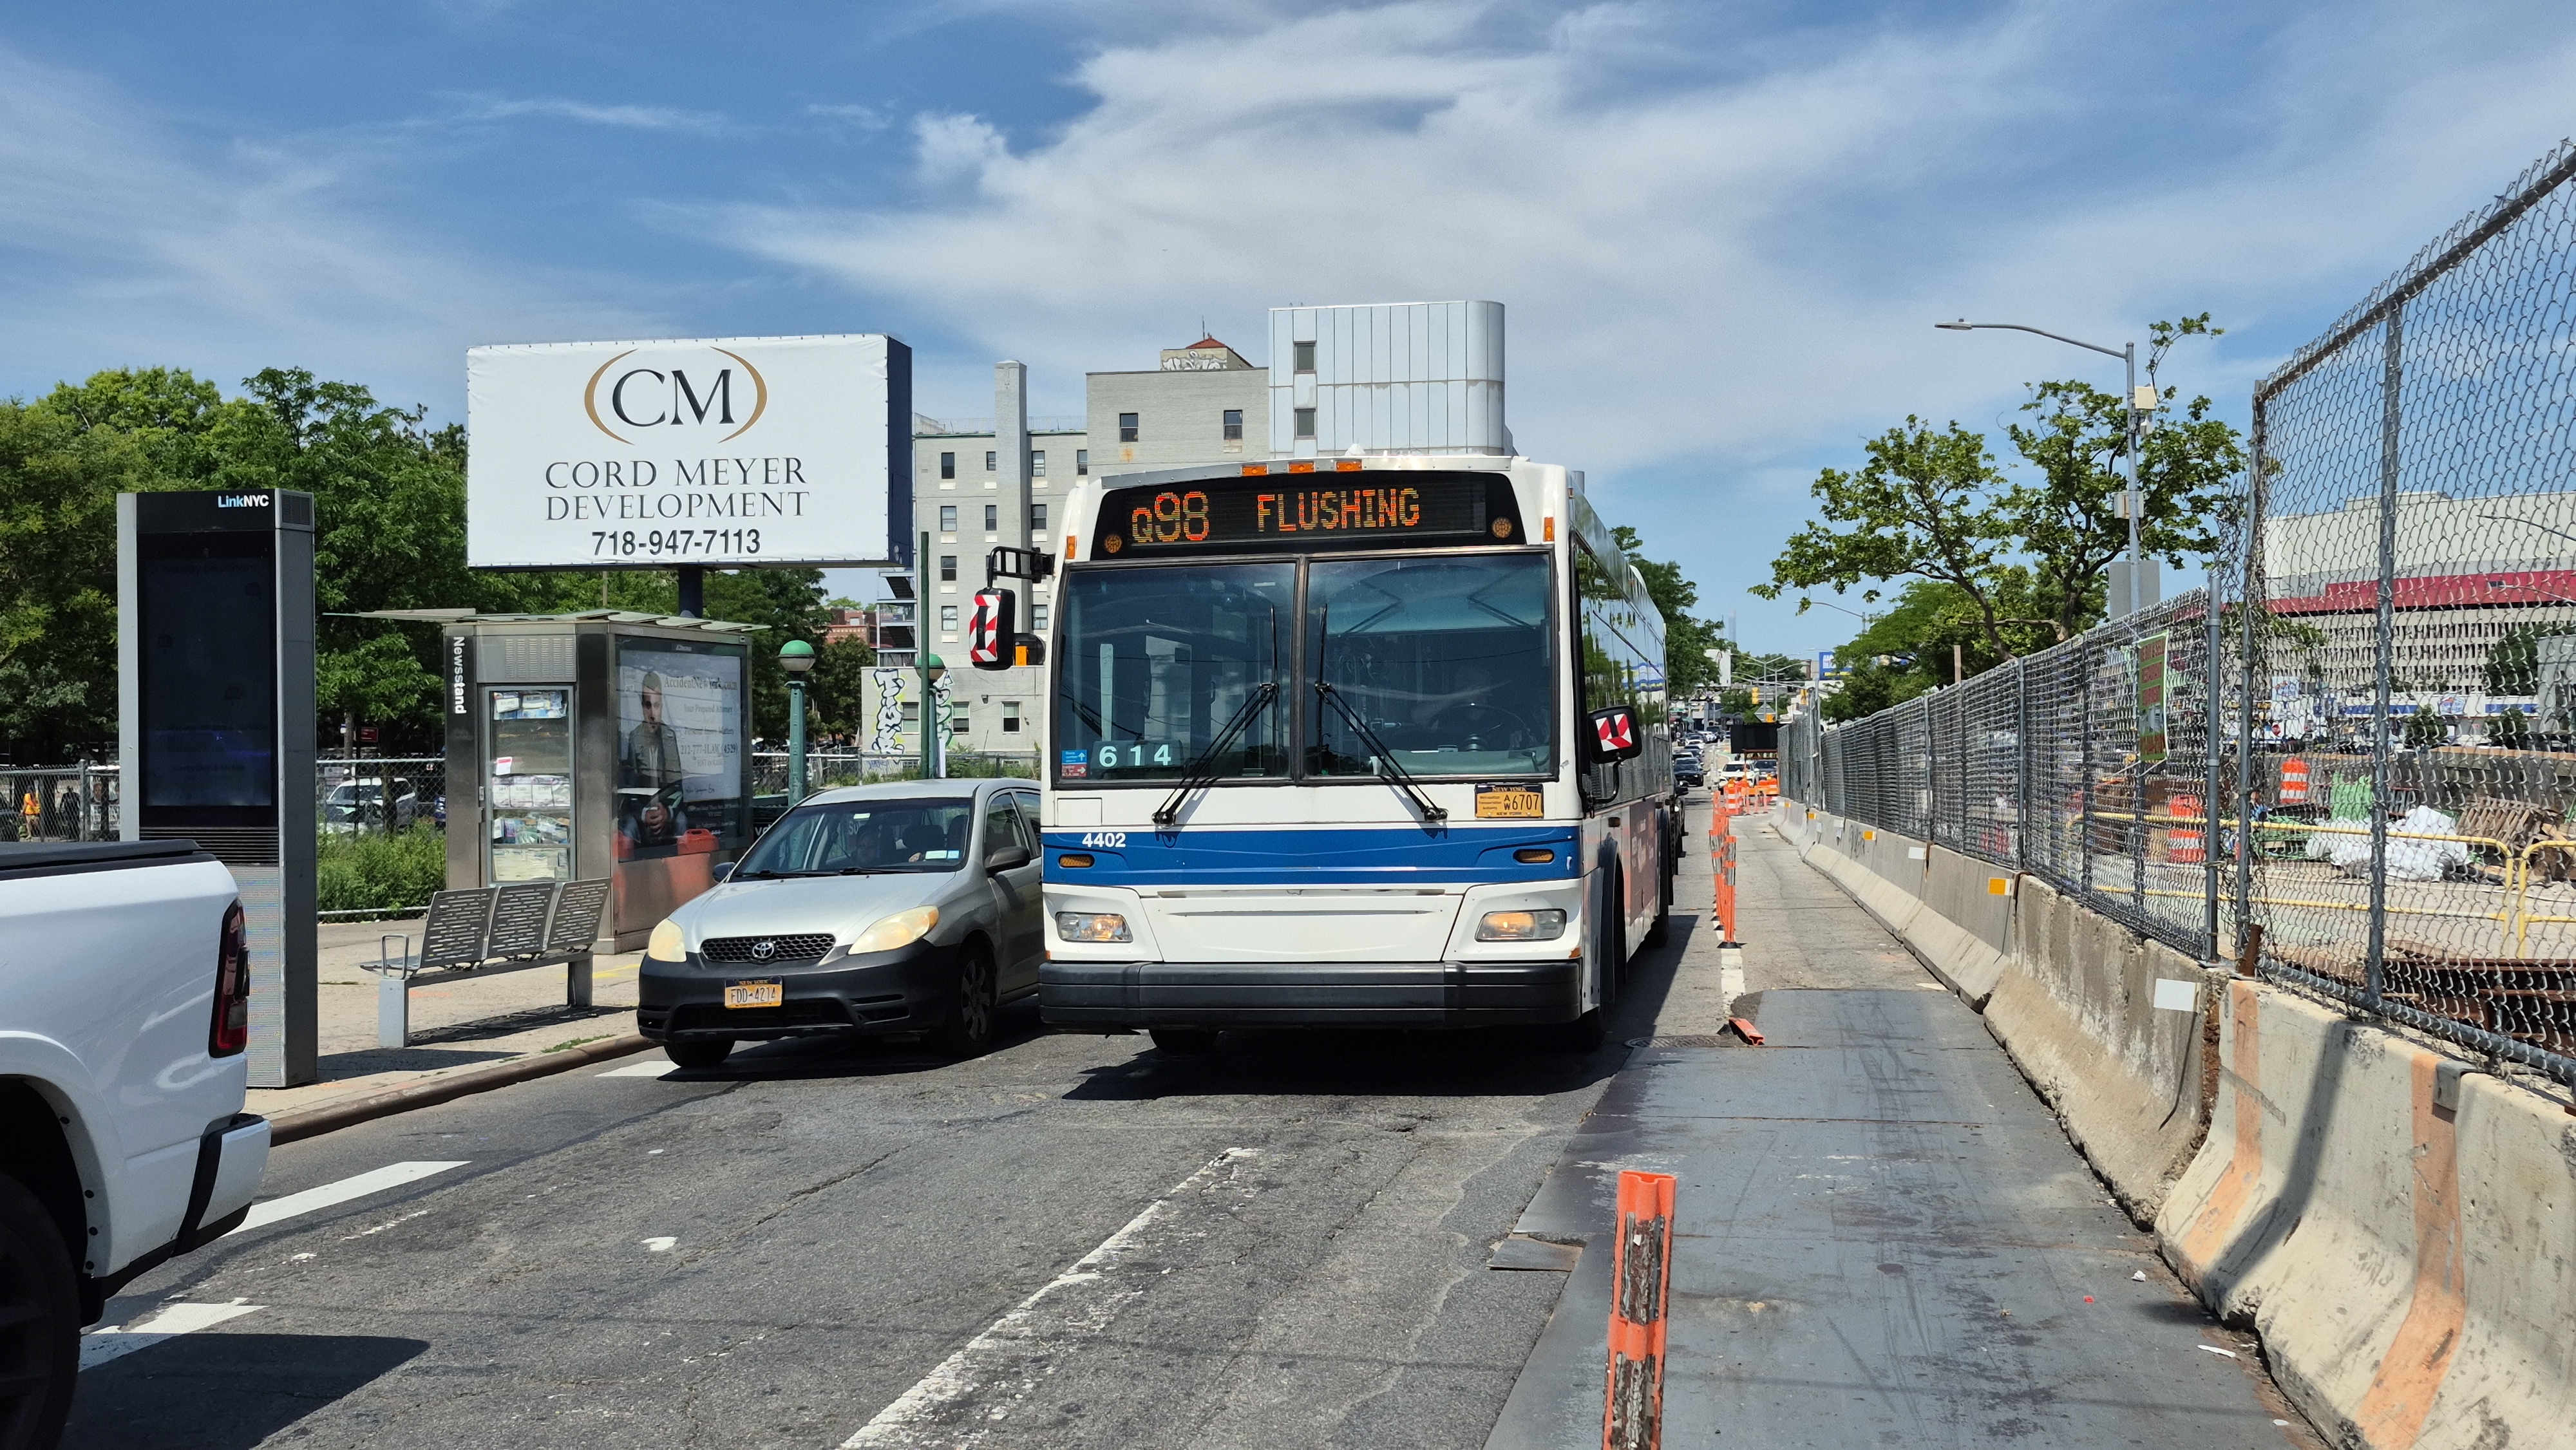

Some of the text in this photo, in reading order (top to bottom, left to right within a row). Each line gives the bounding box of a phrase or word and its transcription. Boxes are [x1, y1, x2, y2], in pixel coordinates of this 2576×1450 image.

[545, 457, 808, 489] CORD MEYER
[218, 494, 269, 508] LinkNYC
[545, 491, 810, 521] DEVELOPMENT
[1132, 487, 1419, 543] Q98 FLUSHING
[592, 529, 761, 556] 718-947-7113
[453, 636, 467, 714] Newsstand
[1082, 833, 1126, 848] 4402
